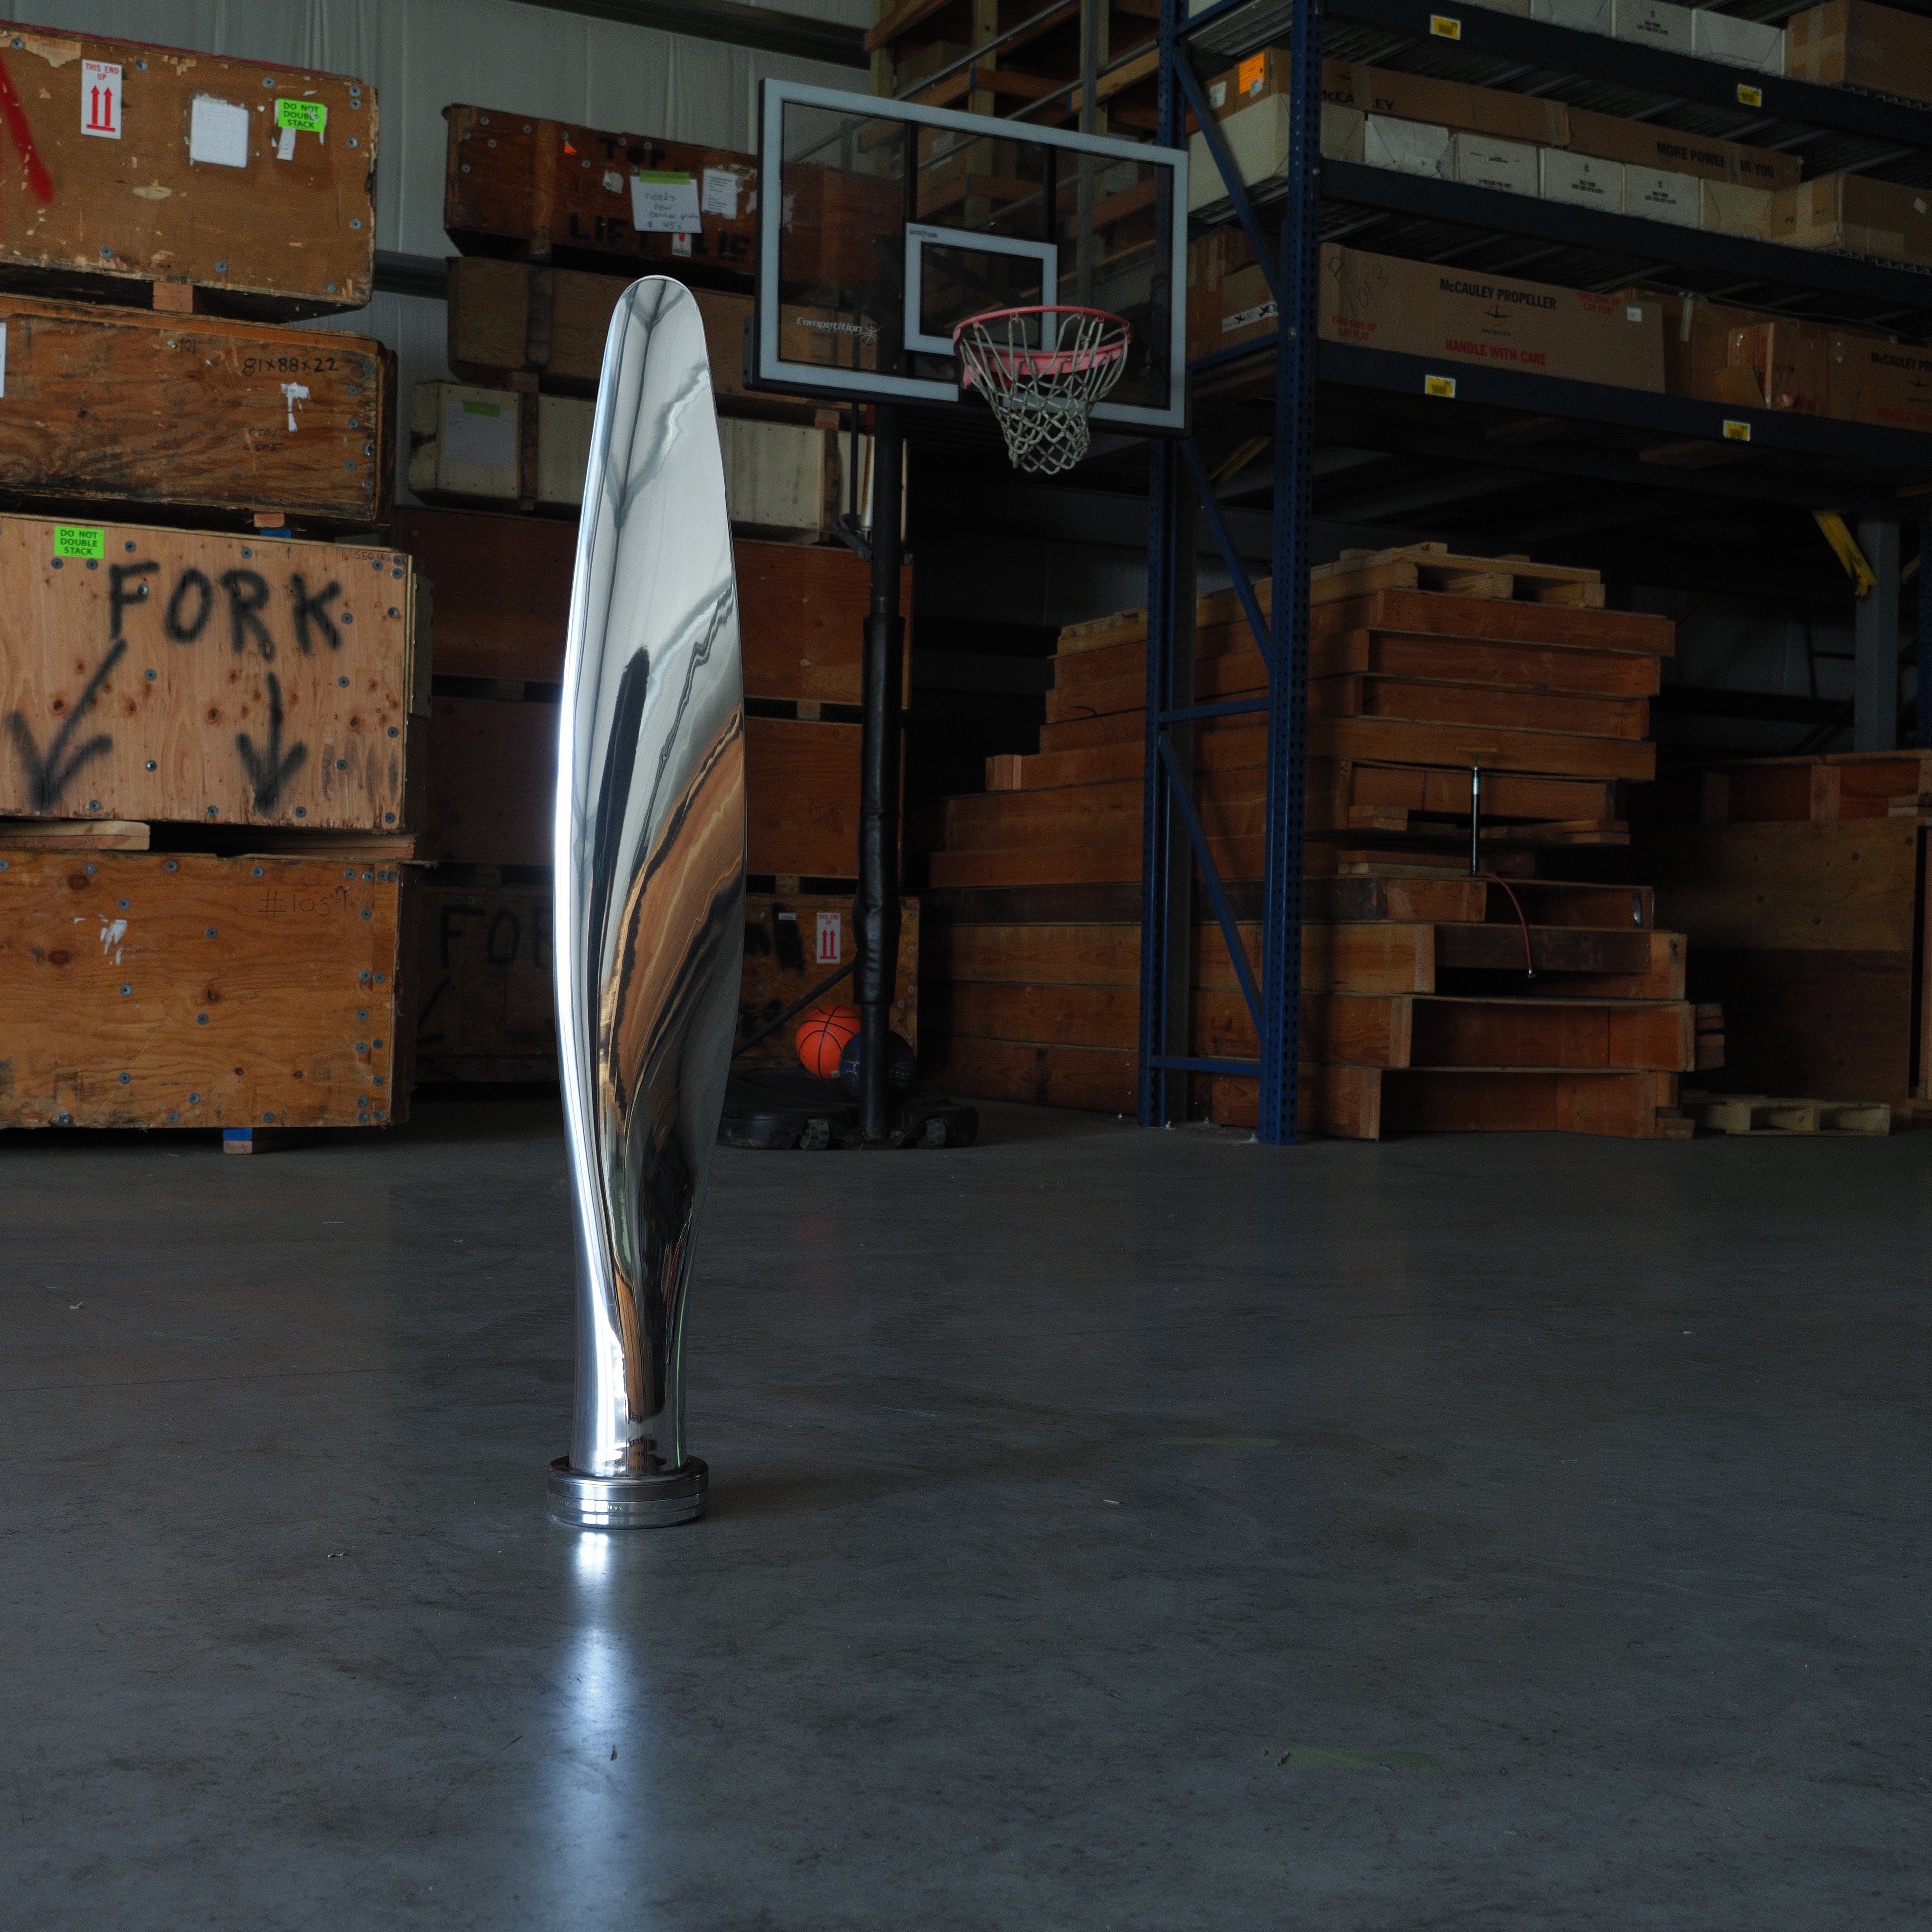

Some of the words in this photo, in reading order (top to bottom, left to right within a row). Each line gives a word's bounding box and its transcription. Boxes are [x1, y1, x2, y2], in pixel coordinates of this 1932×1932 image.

[287, 119, 314, 128] STACK
[1657, 141, 1688, 160] MORE
[1754, 162, 1774, 178] YOU
[1439, 278, 1495, 299] McCAULEY
[1497, 287, 1557, 310] PROPELLER
[796, 317, 862, 333] Competition
[1445, 338, 1487, 357] HANDLE
[1490, 345, 1518, 361] WITH
[1520, 350, 1547, 366] CARE
[1871, 352, 1916, 369] McCAULEY
[1919, 360, 1932, 372] PR
[61, 538, 98, 547] DOUBLE
[354, 551, 374, 560] 550
[109, 561, 342, 663] FORK
